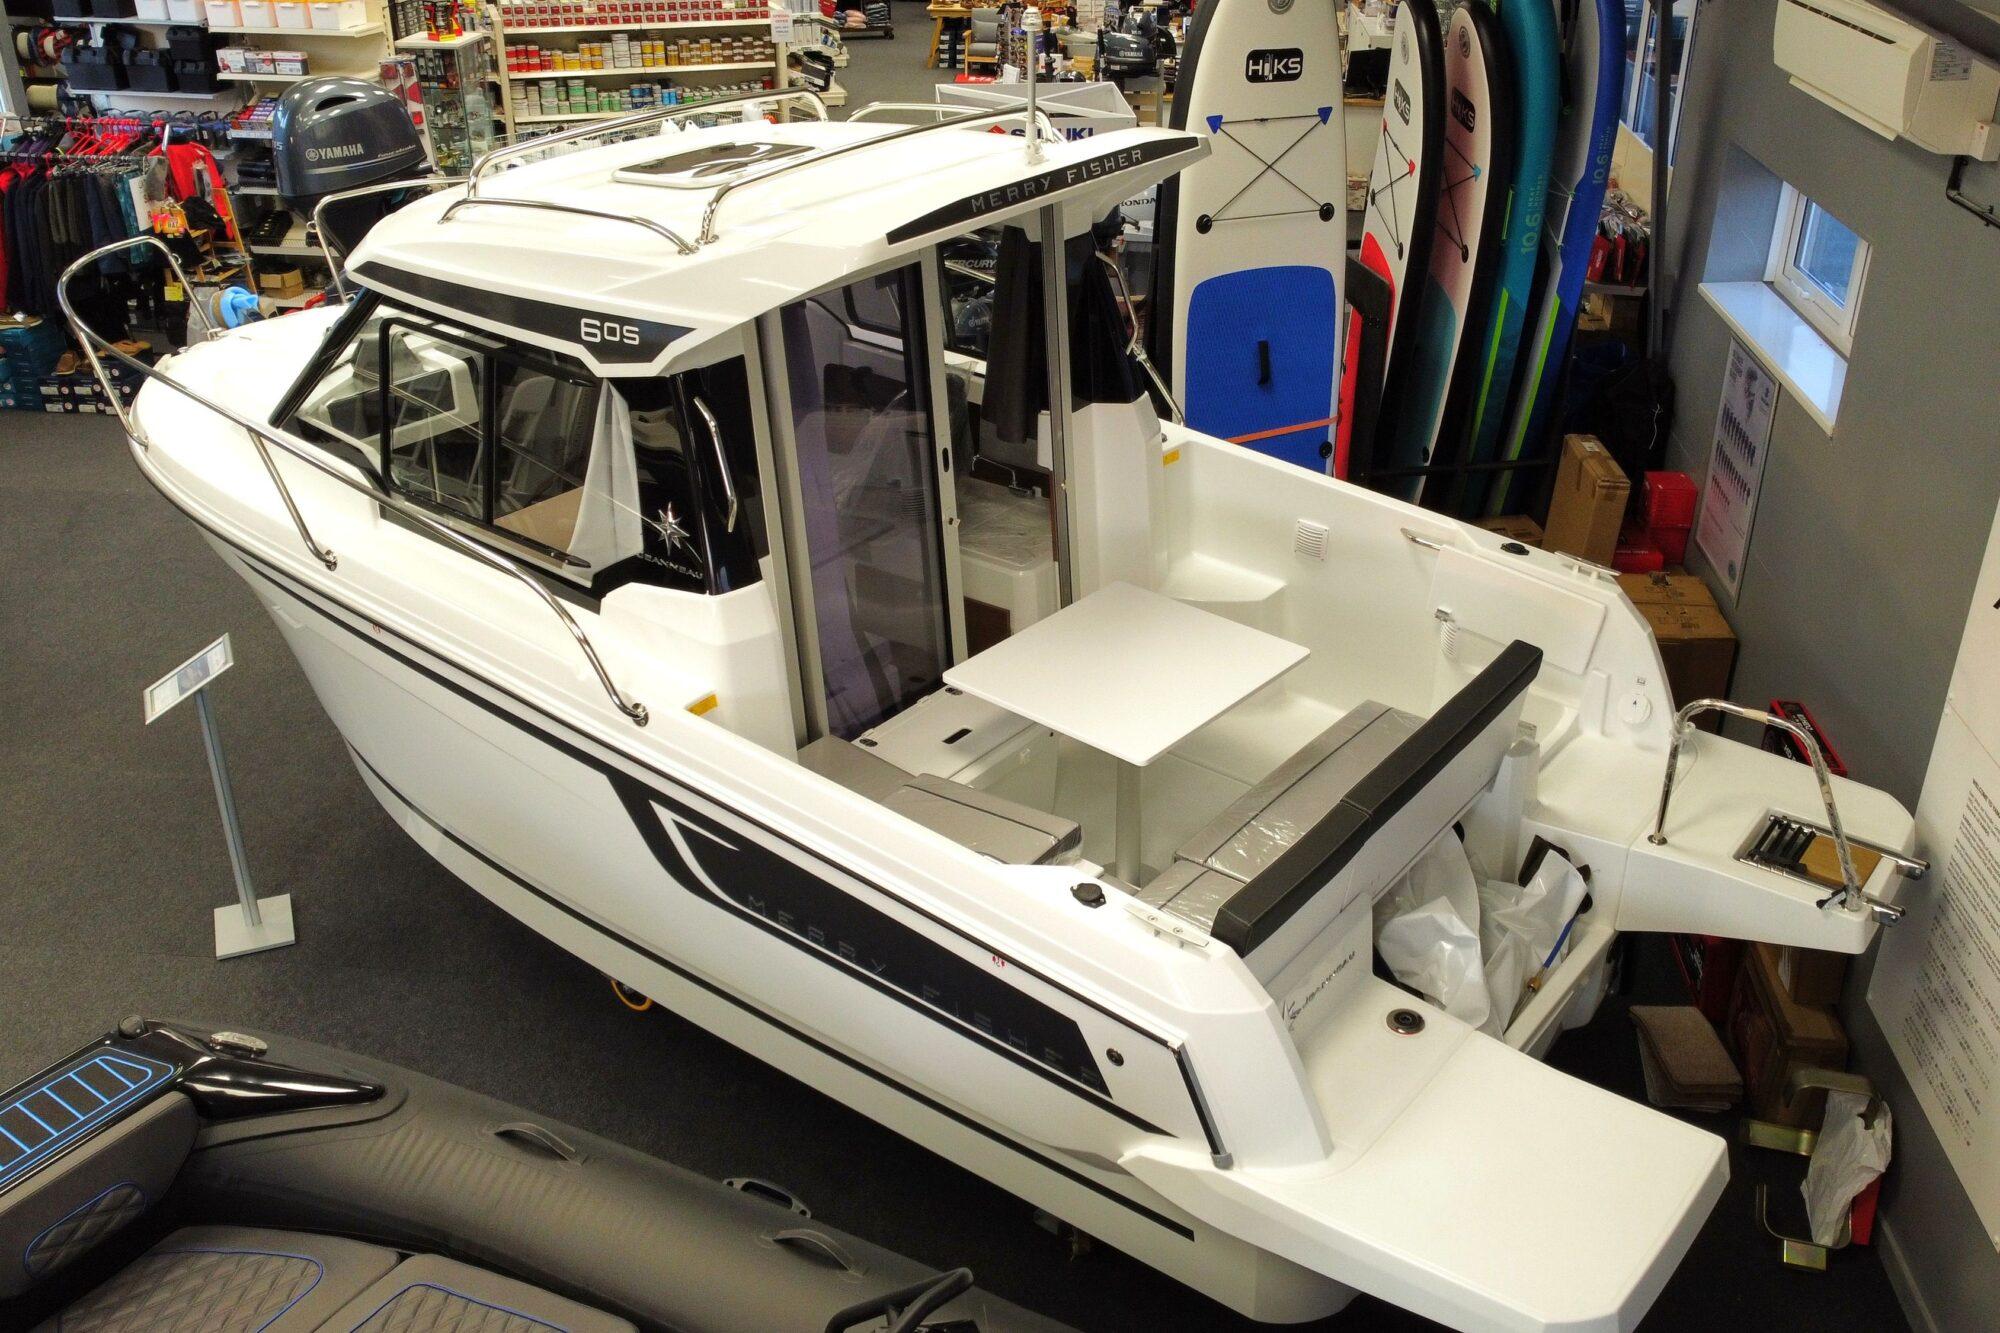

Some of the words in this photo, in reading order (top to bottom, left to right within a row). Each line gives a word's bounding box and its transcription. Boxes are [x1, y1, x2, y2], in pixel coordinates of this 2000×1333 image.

[318, 143, 364, 160] YAMAHA
[972, 177, 1051, 213] MERRY
[1066, 149, 1142, 183] FISHER
